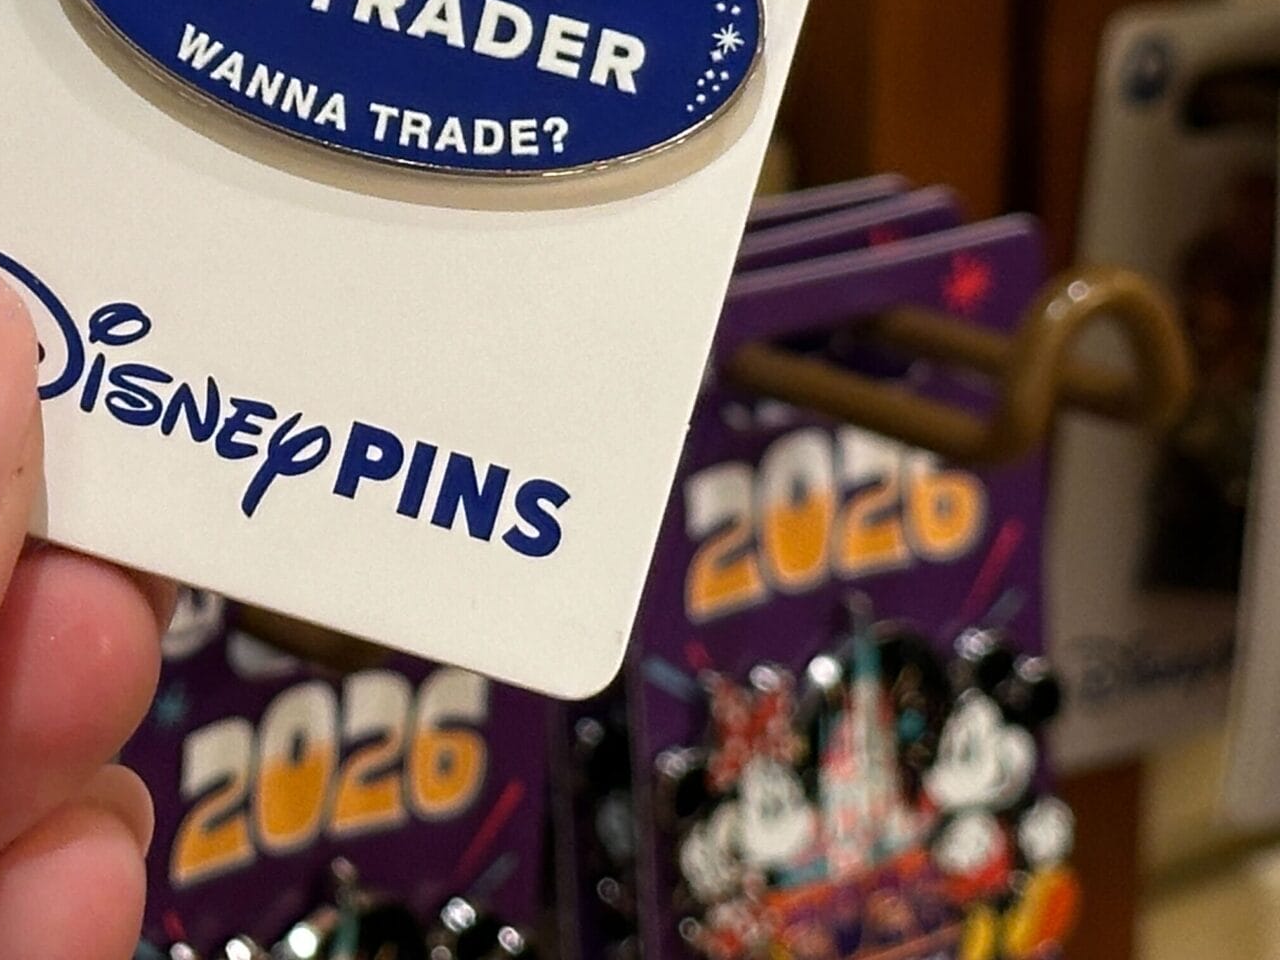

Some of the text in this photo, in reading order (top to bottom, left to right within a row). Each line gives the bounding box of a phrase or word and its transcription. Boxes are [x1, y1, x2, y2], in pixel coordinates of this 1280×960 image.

[176, 23, 570, 156] WANNA TRADE?
[333, 420, 570, 558] PINS
[684, 426, 987, 623] 2026
[170, 666, 489, 886] 2026
